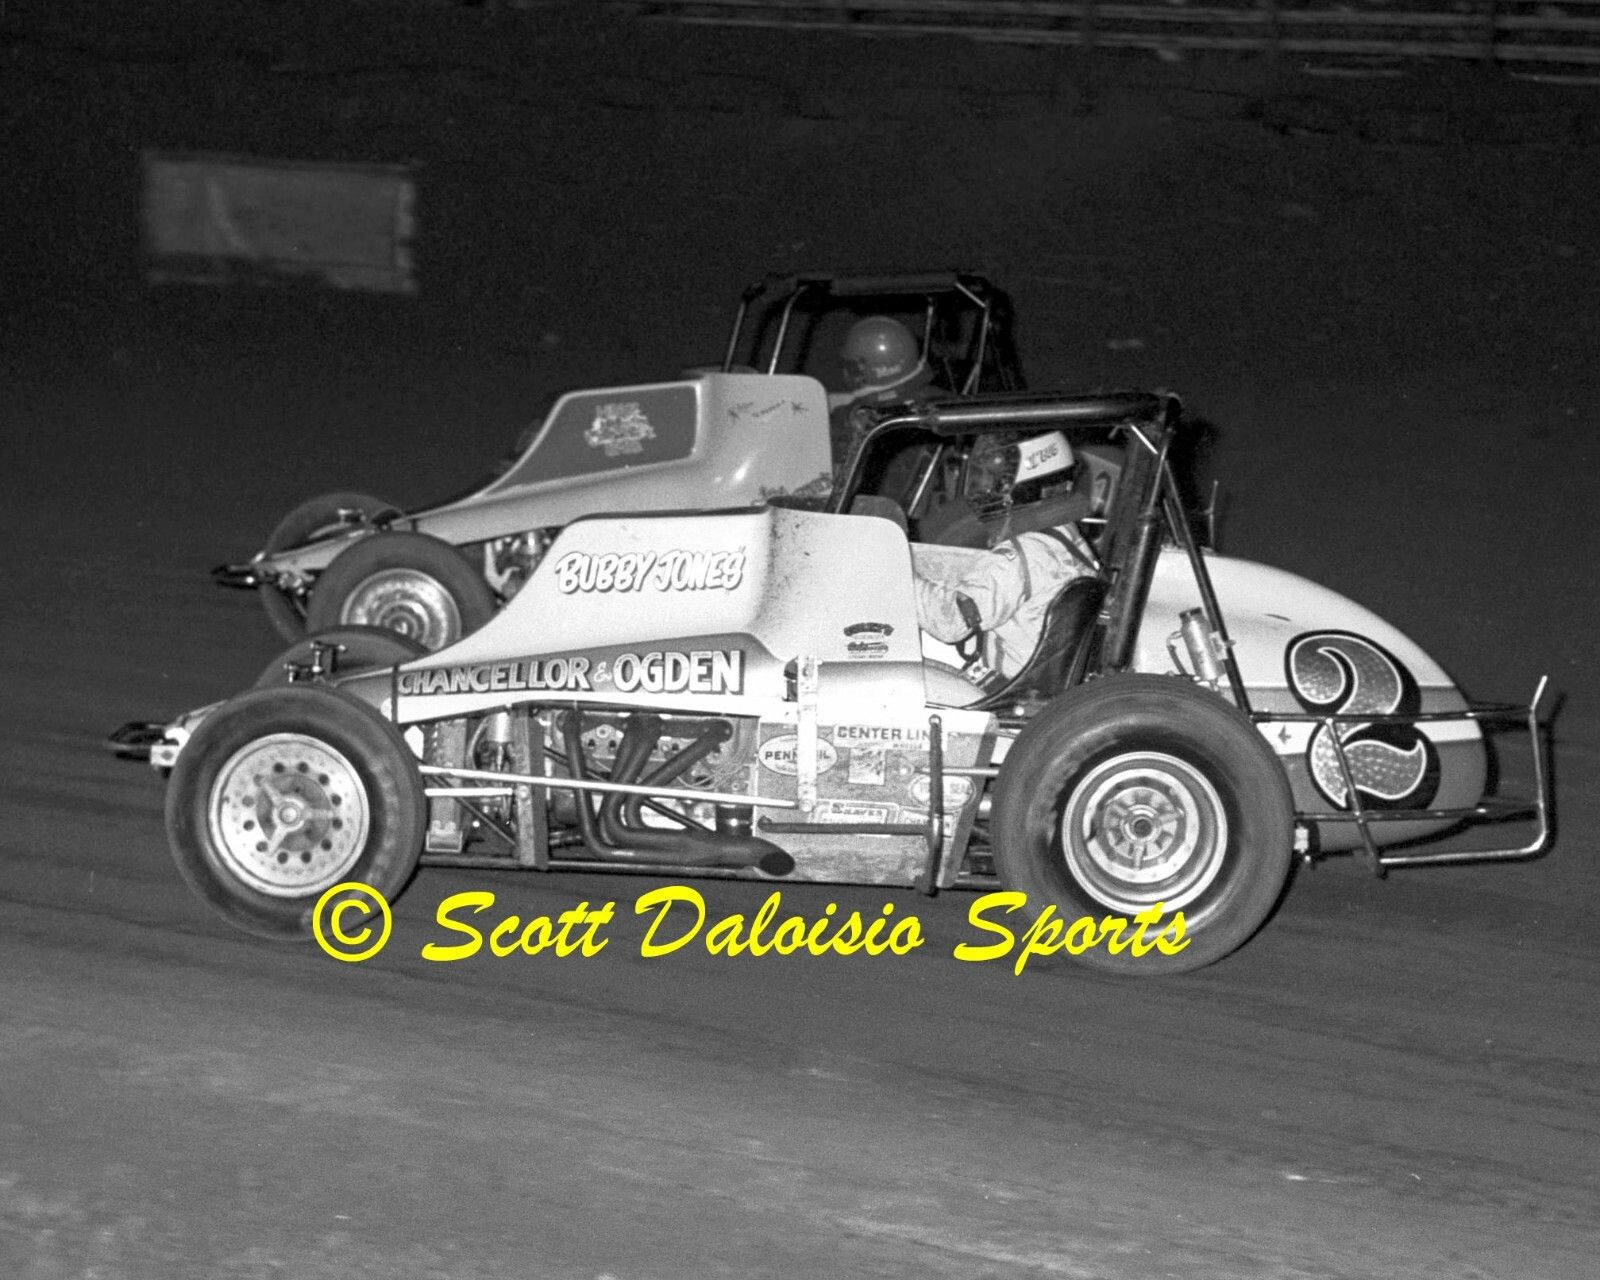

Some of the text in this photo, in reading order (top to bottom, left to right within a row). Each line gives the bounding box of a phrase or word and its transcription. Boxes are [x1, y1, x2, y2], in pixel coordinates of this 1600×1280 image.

[554, 548, 747, 595] BUBBY JONES
[398, 656, 592, 695] CHANCELLOR
[612, 650, 745, 695] OGDEN
[837, 725, 931, 741] CENTER LIN
[765, 749, 831, 761] PENNIL
